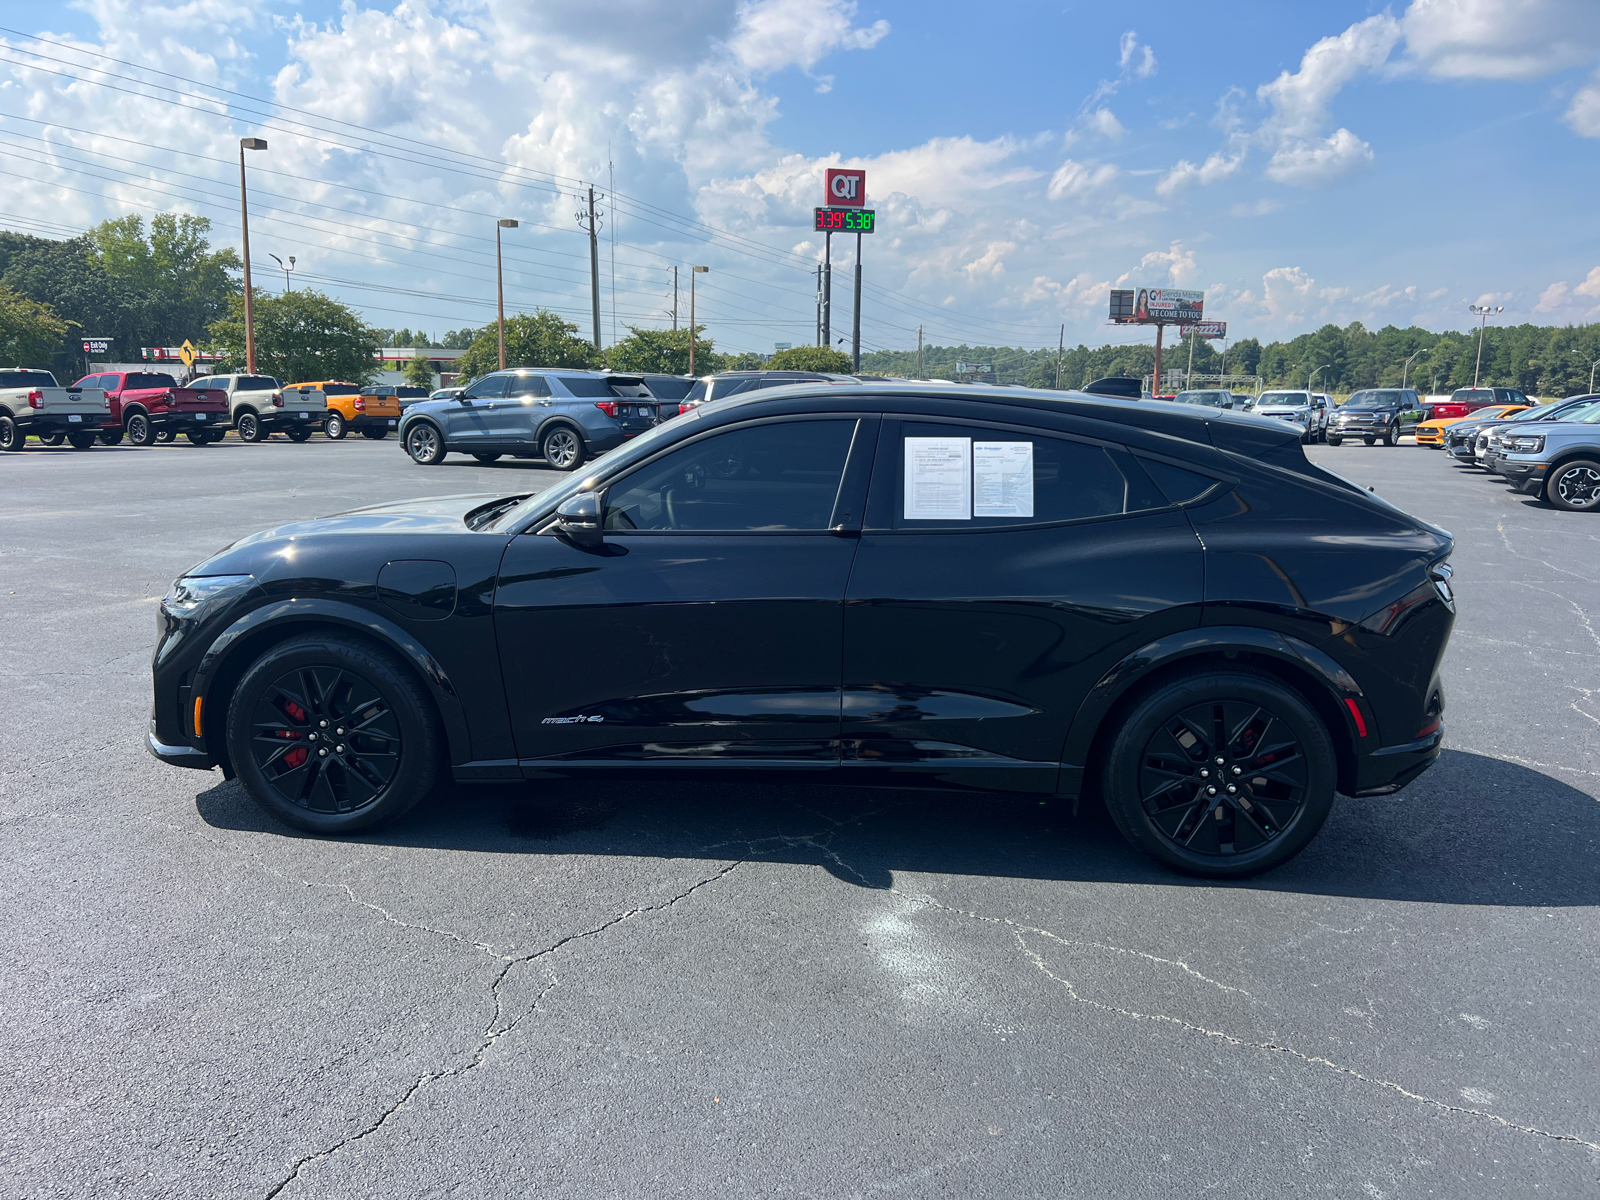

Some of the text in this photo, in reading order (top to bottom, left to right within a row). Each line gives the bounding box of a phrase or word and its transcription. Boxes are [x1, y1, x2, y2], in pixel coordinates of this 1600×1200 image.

[831, 174, 860, 200] QT
[1162, 290, 1182, 298] Glenda
[1160, 310, 1177, 318] COME
[335, 647, 389, 681] ALENZA
[541, 714, 587, 724] mach
